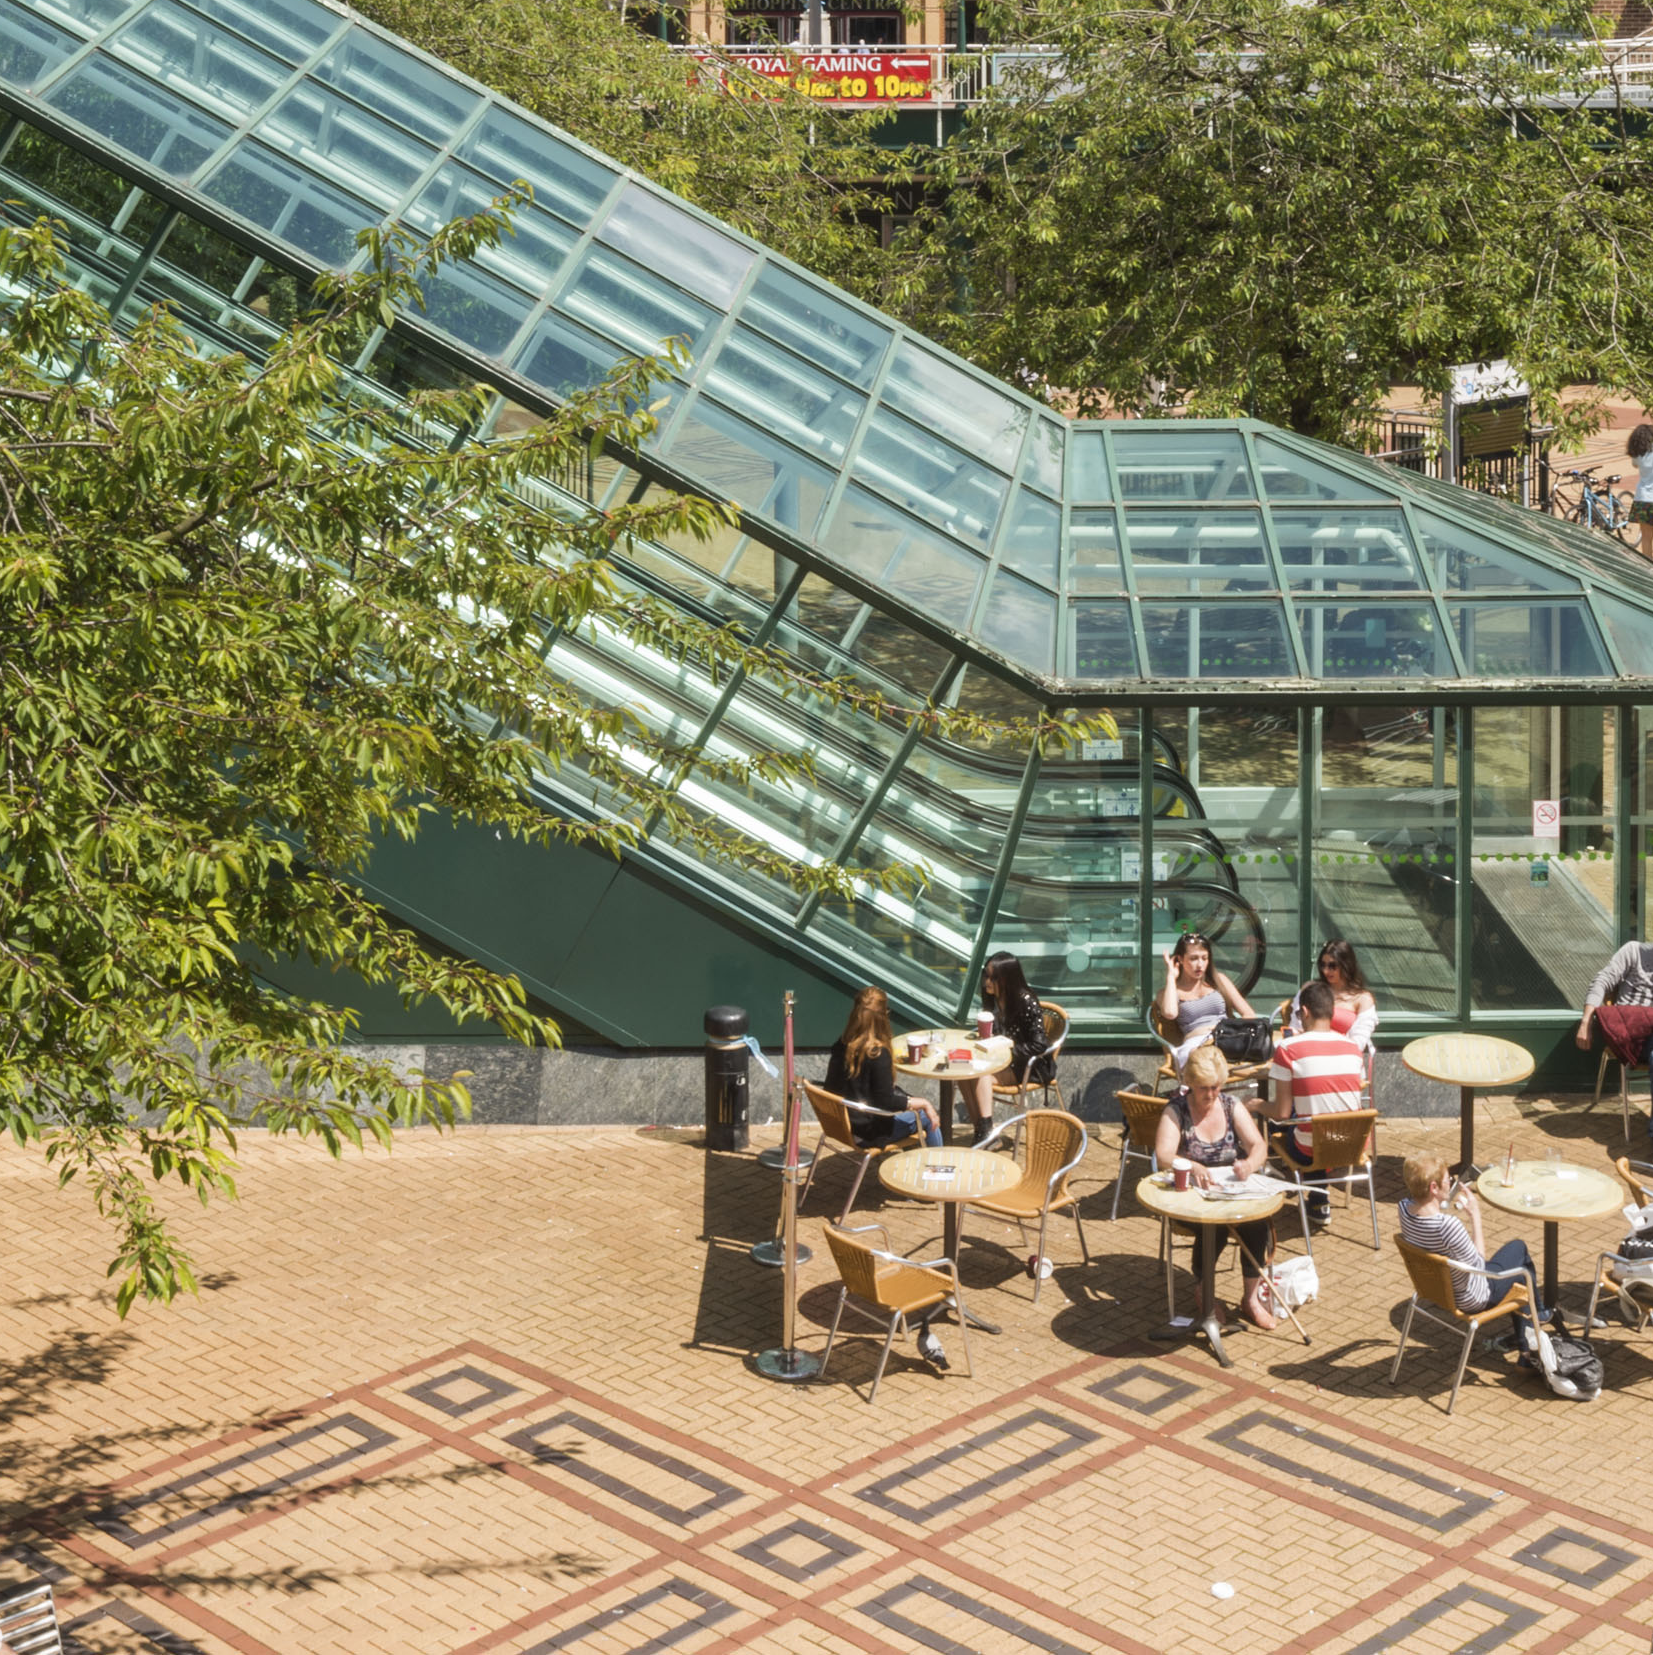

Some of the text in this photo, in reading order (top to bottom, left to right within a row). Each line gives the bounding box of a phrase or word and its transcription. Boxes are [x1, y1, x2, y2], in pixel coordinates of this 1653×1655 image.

[801, 56, 882, 73] GAMING
[840, 75, 868, 98] to
[874, 74, 925, 98] 10PM
